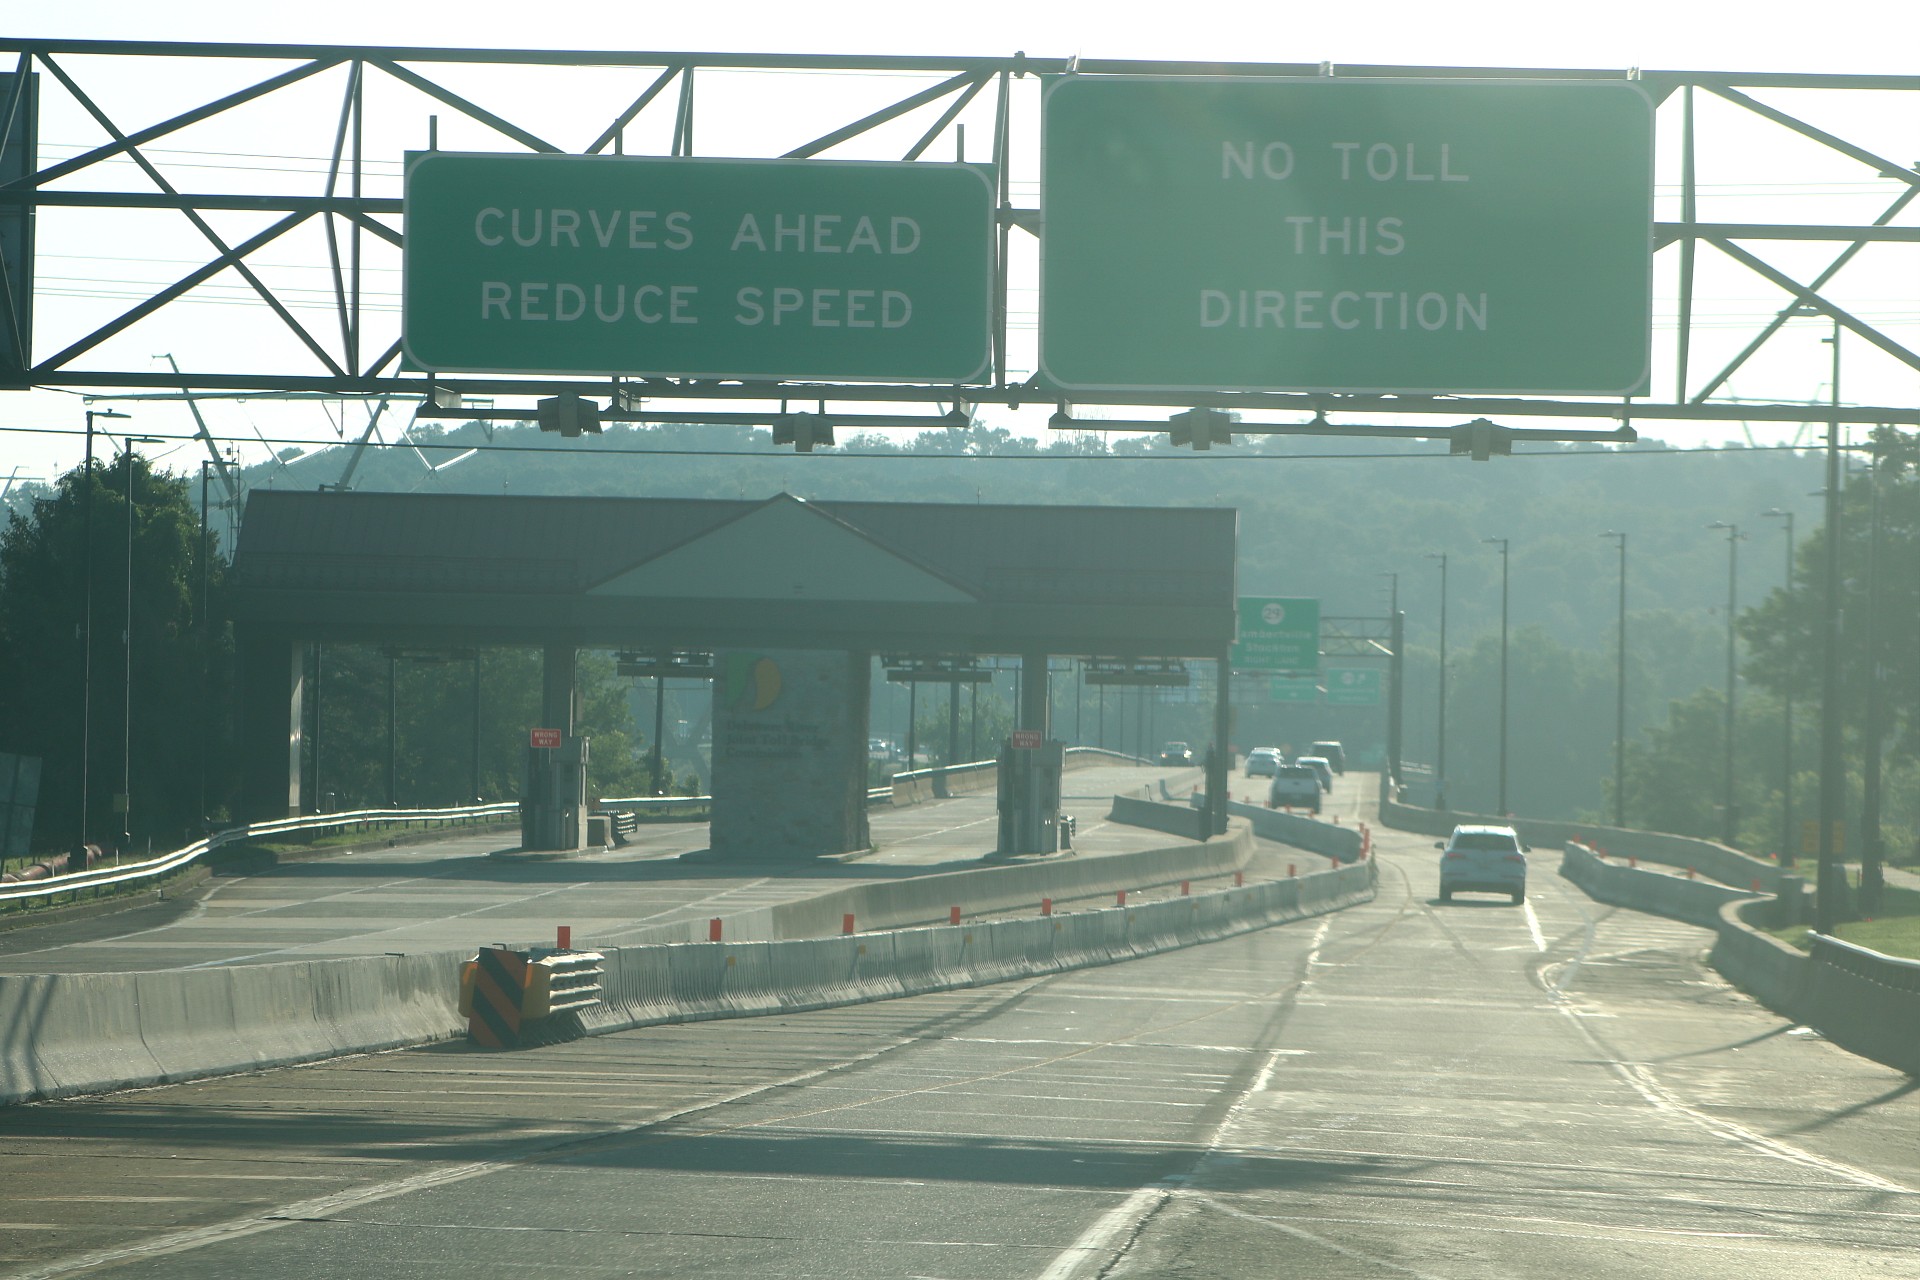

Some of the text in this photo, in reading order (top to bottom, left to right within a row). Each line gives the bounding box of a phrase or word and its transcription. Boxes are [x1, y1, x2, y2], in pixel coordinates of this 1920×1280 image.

[1221, 140, 1470, 182] NO TOLL
[474, 207, 922, 255] CURVES AHEAD
[1286, 216, 1405, 255] THIS
[481, 281, 913, 329] REDUCE SPEED
[1200, 289, 1488, 331] DIRECTION
